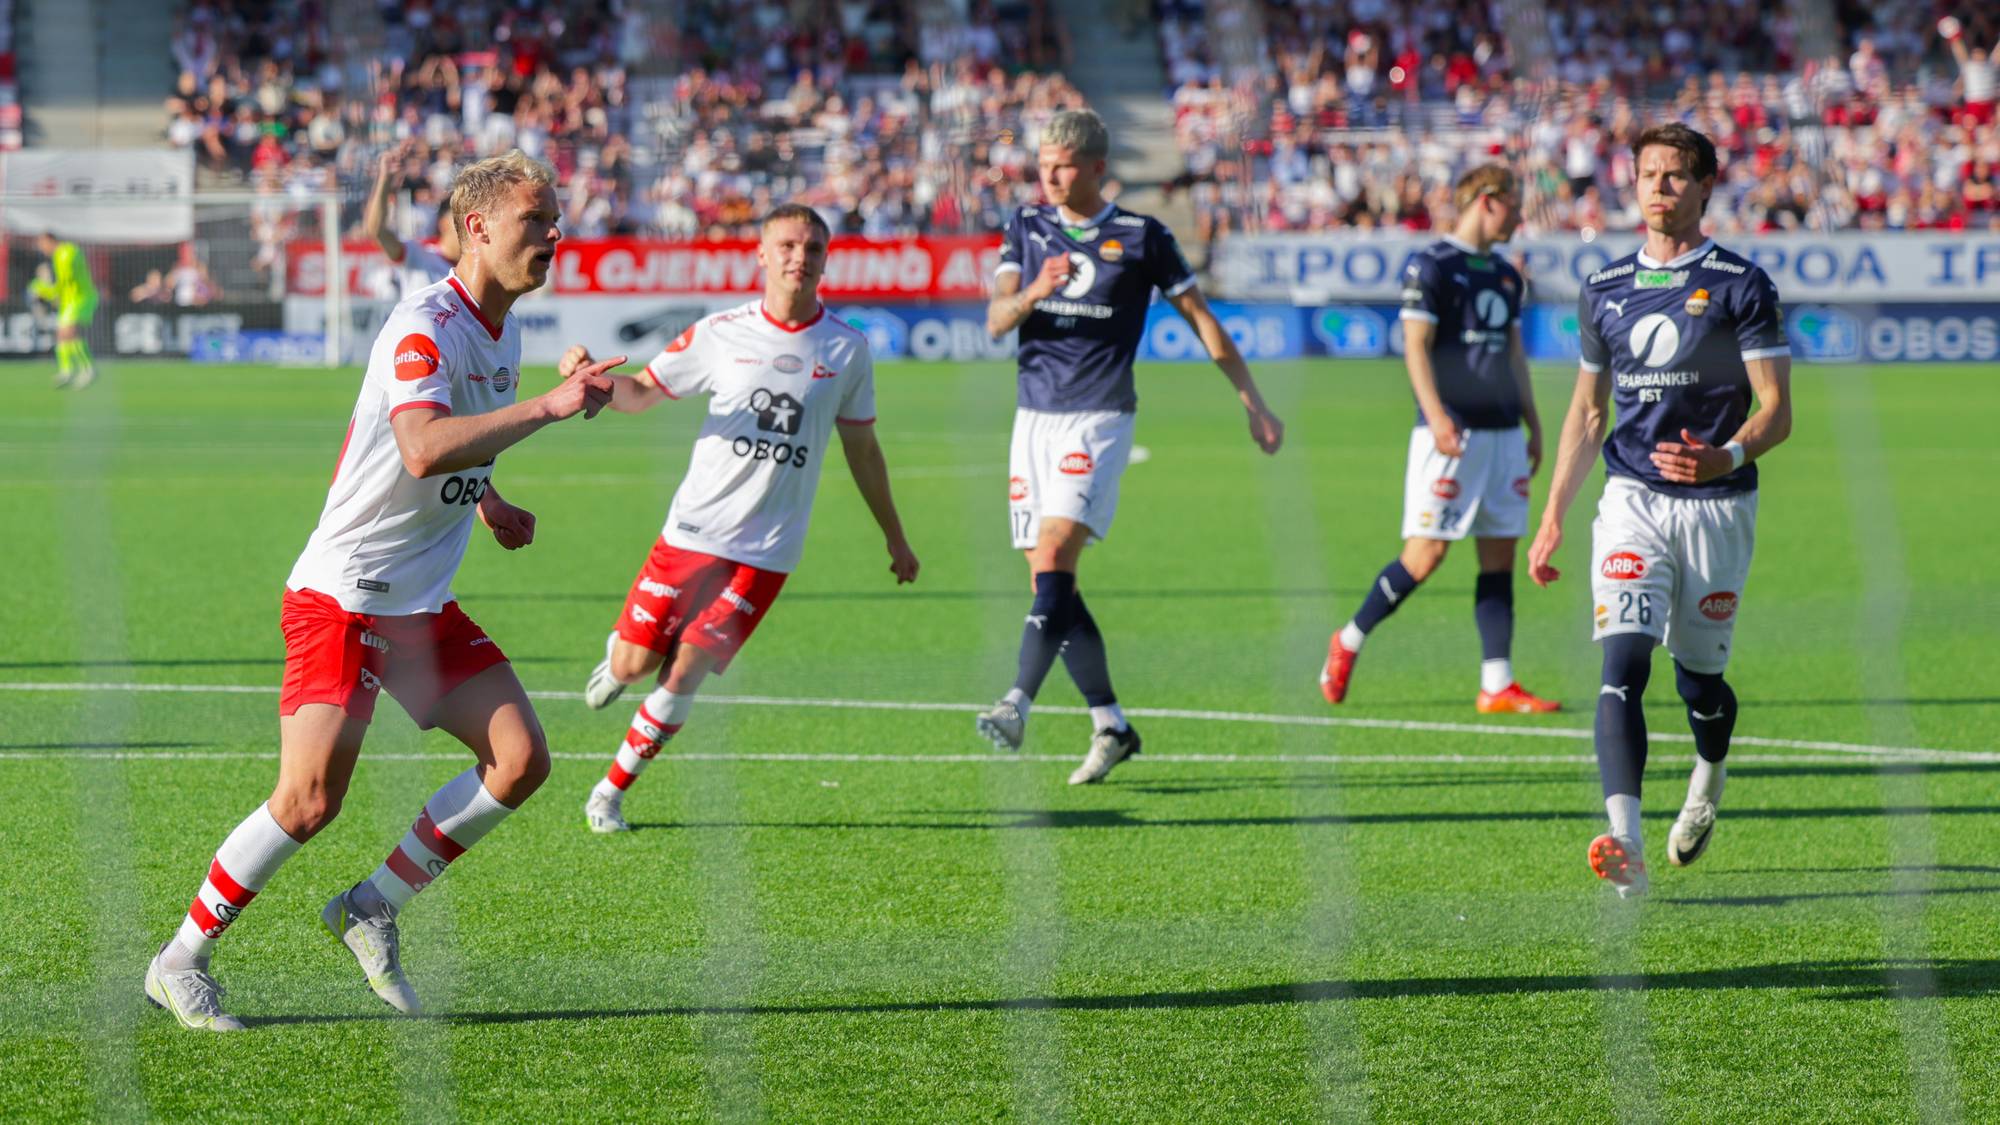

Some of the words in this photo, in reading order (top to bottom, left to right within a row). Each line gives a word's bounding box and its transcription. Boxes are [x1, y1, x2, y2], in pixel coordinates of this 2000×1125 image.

[1868, 316, 2000, 361] OBOS
[732, 436, 809, 469] OBOS
[440, 476, 490, 506] OBO
[1013, 511, 1032, 540] 17
[1603, 558, 1648, 575] ARBO
[1619, 591, 1652, 626] 26
